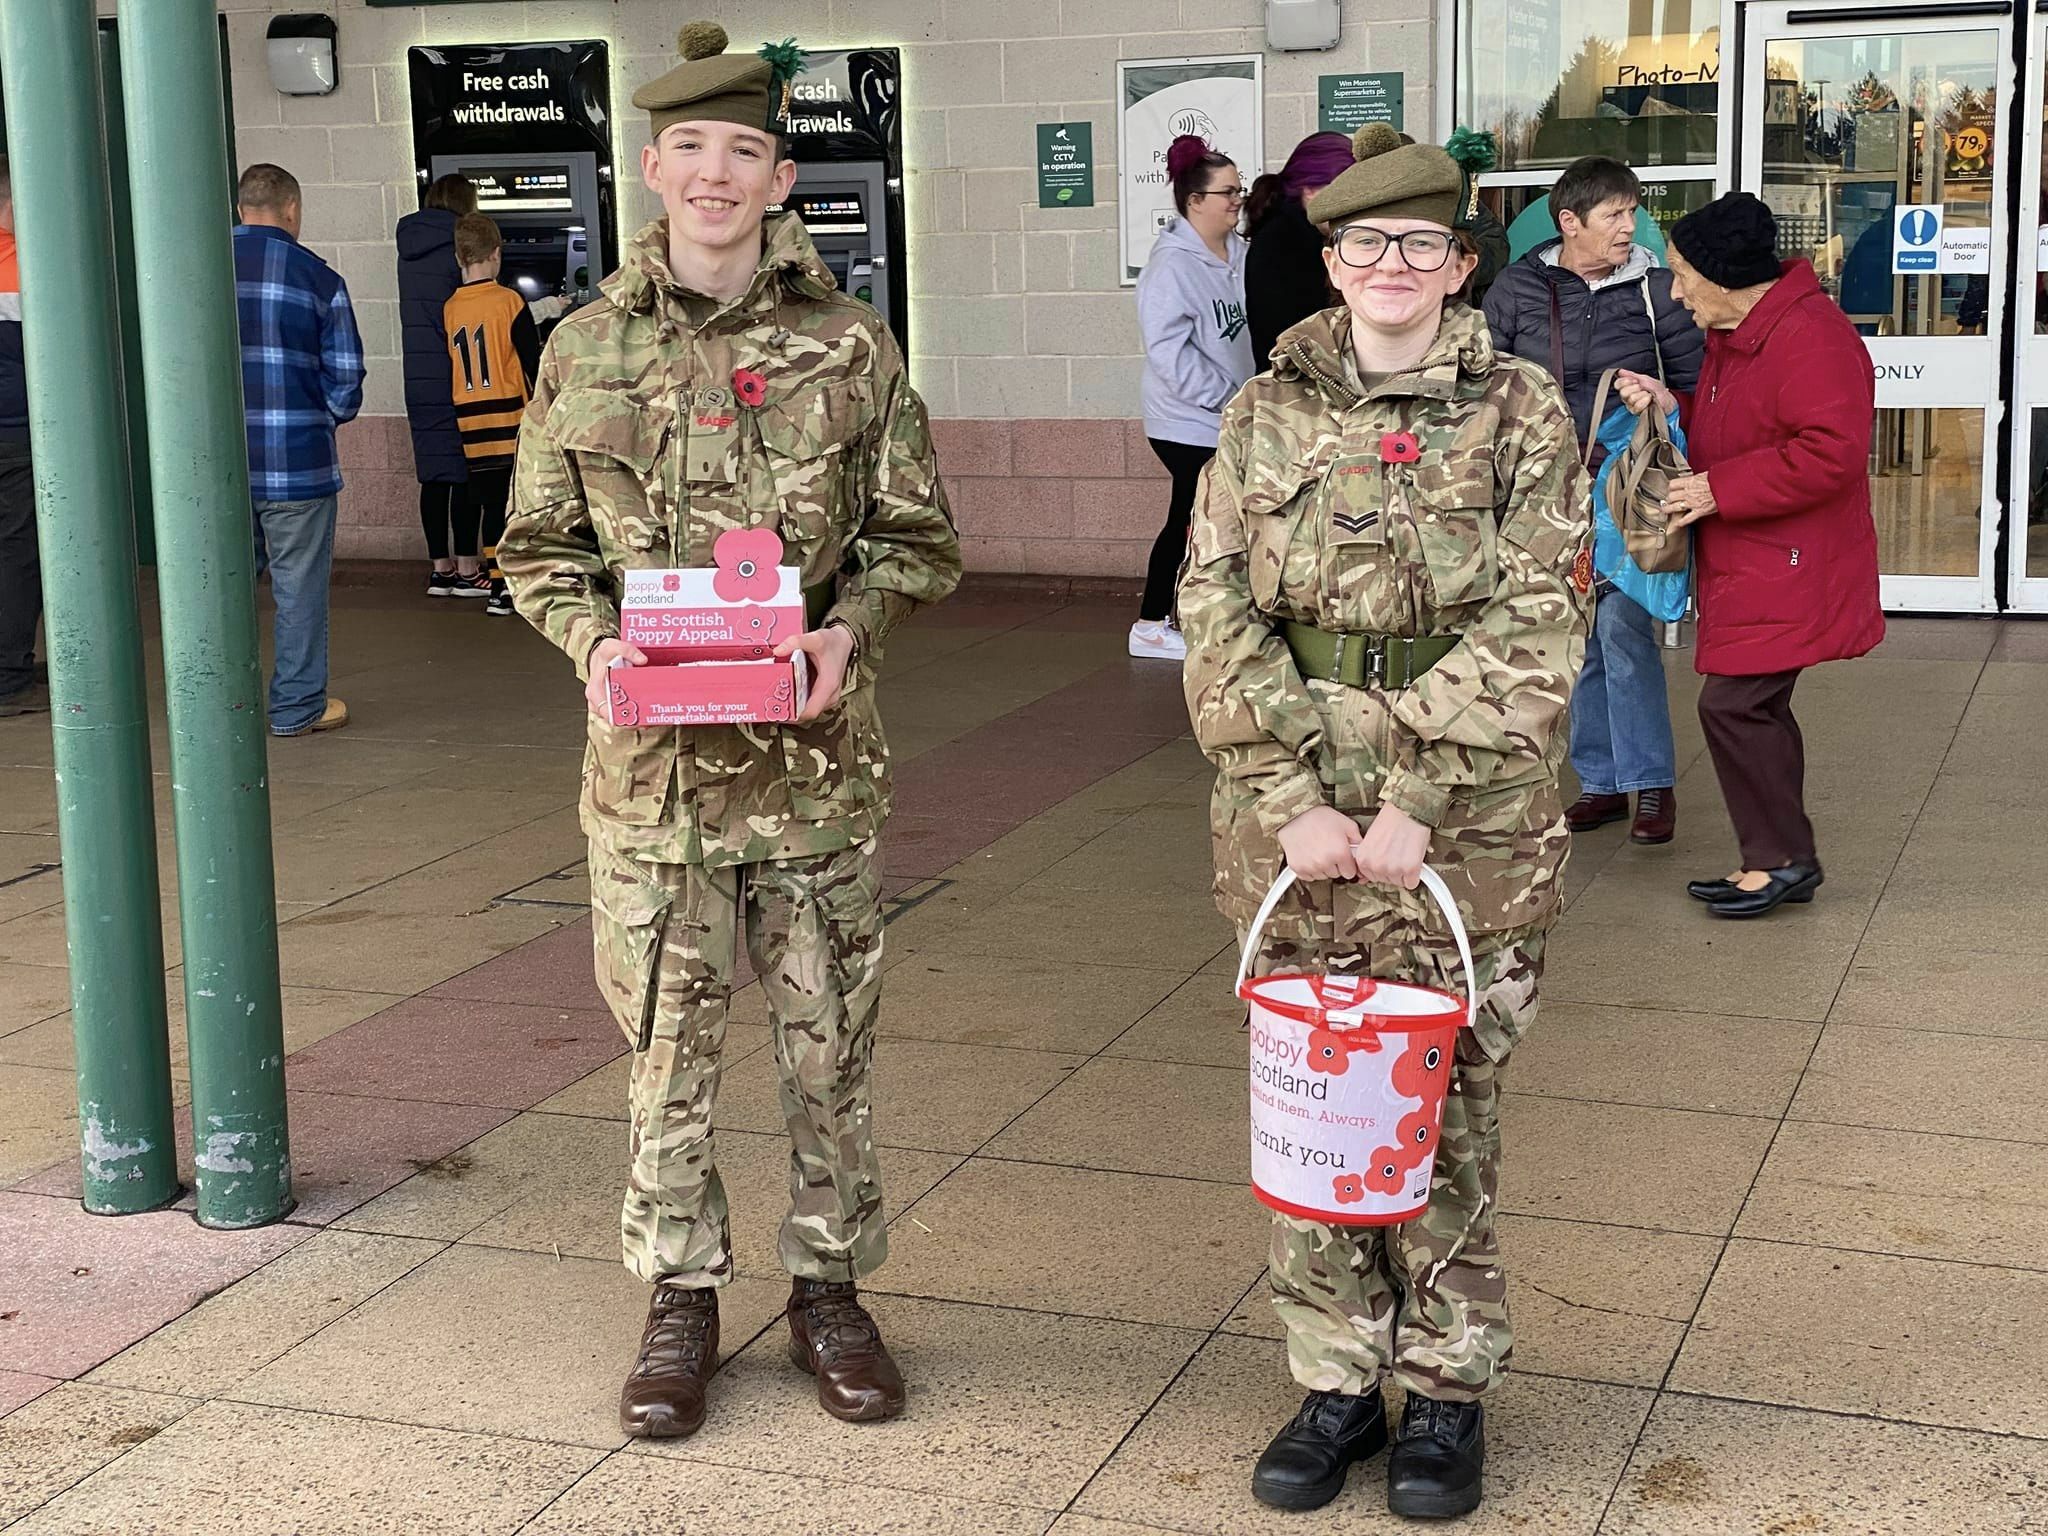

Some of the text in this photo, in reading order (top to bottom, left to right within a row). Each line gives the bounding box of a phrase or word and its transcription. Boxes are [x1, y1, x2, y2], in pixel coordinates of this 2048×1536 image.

[463, 68, 549, 91] Free cash
[1339, 79, 1352, 87] Wm
[794, 77, 837, 100] cash
[1333, 88, 1386, 98] Supermarkets plc
[453, 100, 564, 123] withdrawals
[1051, 144, 1076, 152] Warning
[1053, 153, 1074, 161] CCTV
[1153, 150, 1168, 163] Pa
[1051, 162, 1086, 172] operation
[1135, 169, 1165, 184] with
[1942, 242, 1988, 250] Automatic
[1953, 252, 1976, 261] Door
[453, 324, 490, 391] 11
[1874, 365, 1925, 379] ONLY
[1338, 464, 1375, 476] CADET
[626, 582, 661, 593] poppy
[628, 594, 674, 604] scotland
[626, 612, 725, 627] The Scottish
[627, 626, 733, 645] Poppy Appeal
[650, 702, 749, 713] Thank you for your
[646, 712, 757, 725] unforgettable support
[1251, 1055, 1328, 1101] scotland
[1277, 1098, 1314, 1120] them.
[1299, 1145, 1345, 1168] you
